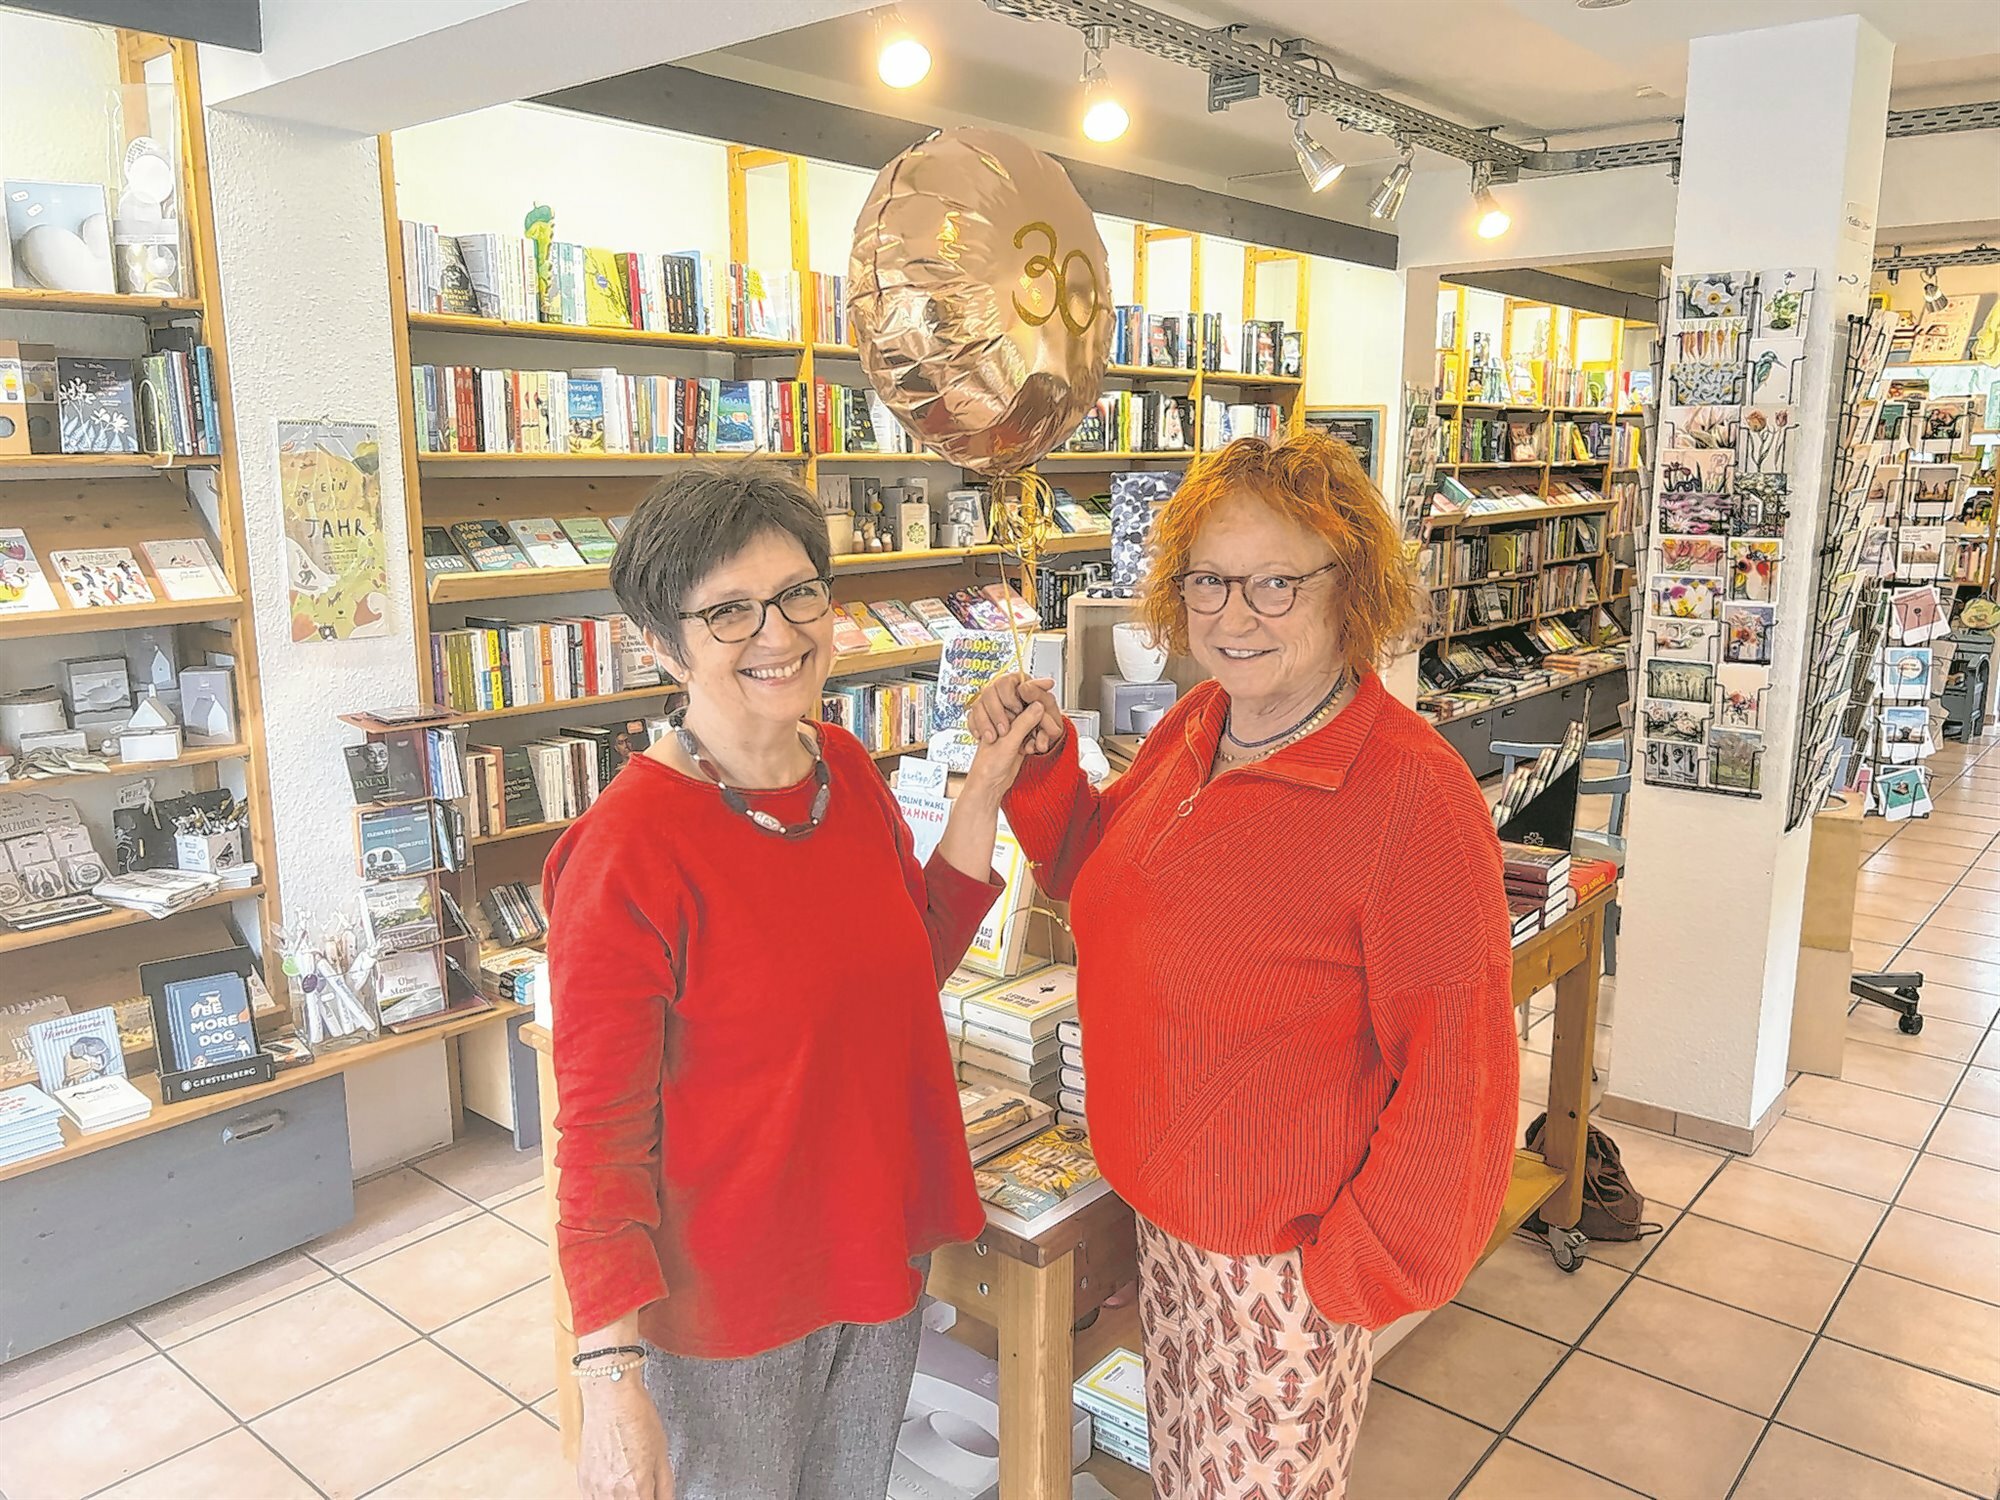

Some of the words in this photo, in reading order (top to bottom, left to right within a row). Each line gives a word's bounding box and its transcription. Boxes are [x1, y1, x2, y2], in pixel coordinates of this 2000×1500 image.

[1012, 221, 1098, 337] 30
[305, 518, 366, 538] JAHR
[203, 1002, 224, 1017] BE
[190, 1014, 239, 1034] MORE
[199, 1029, 236, 1047] DOG
